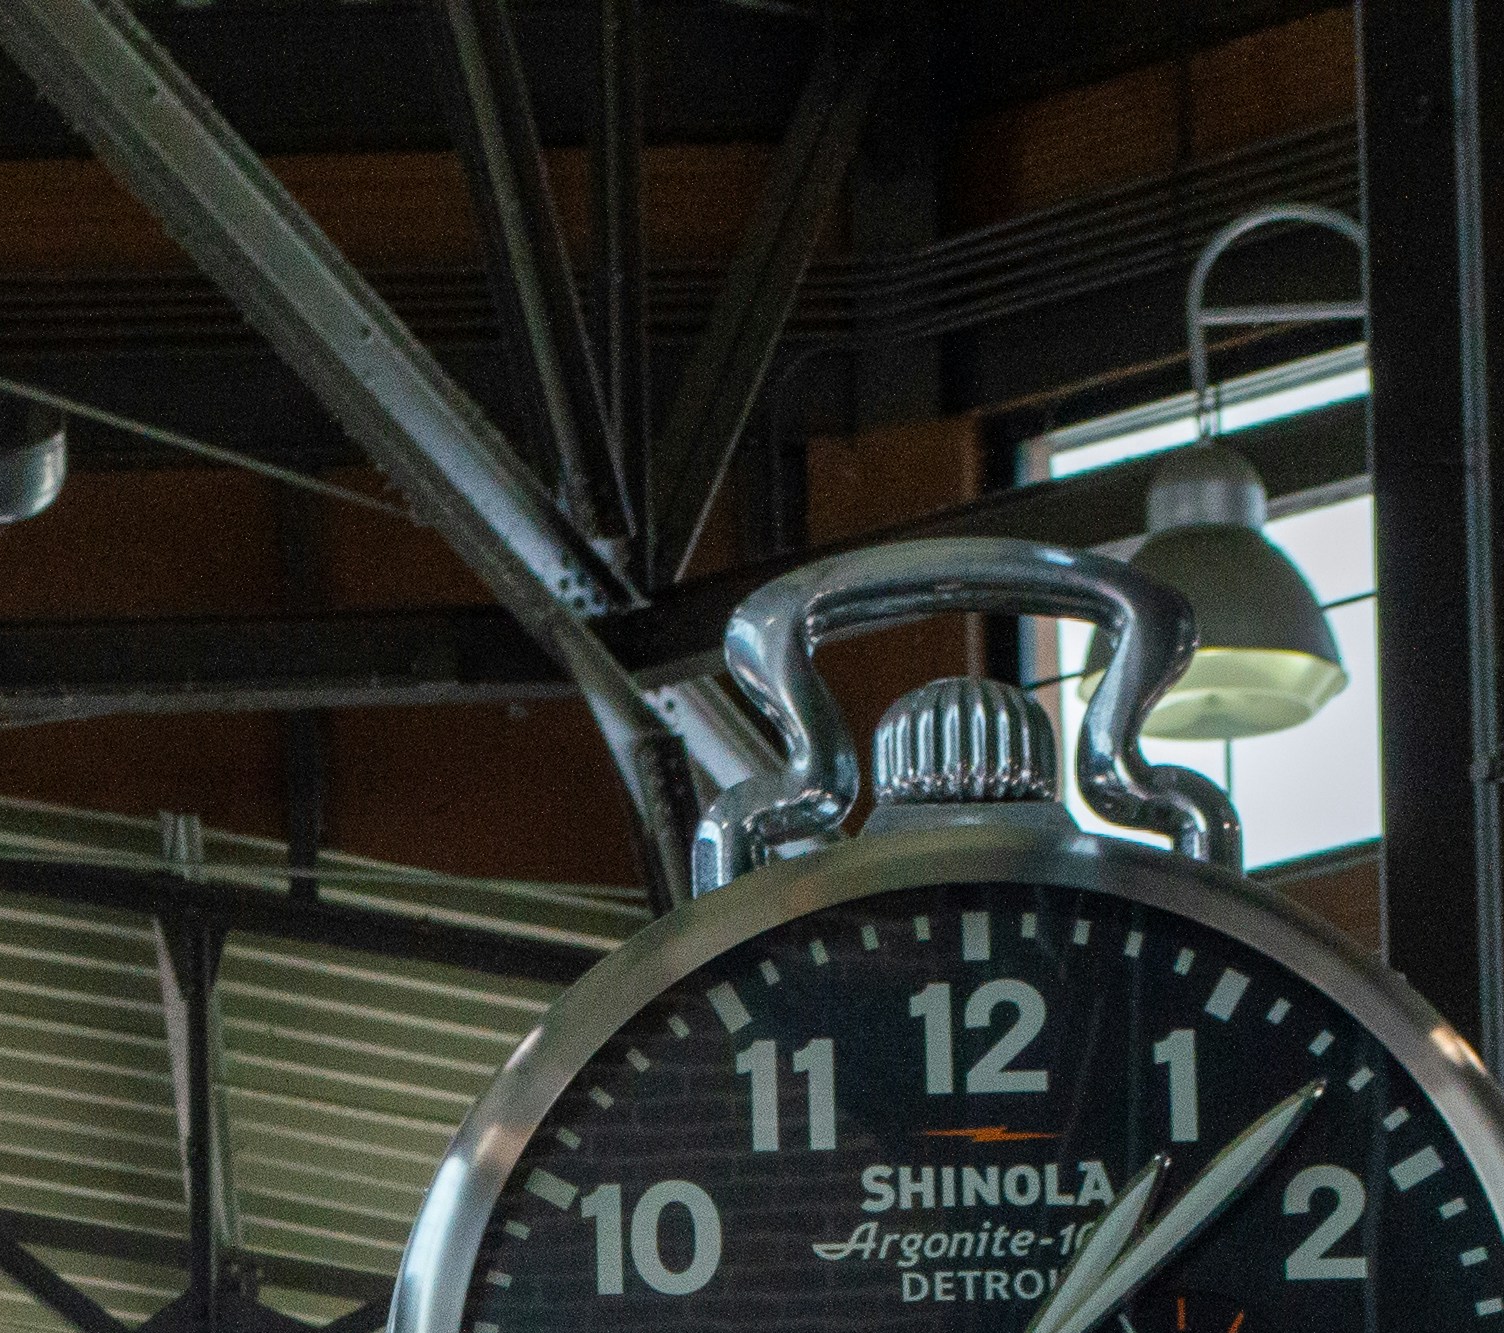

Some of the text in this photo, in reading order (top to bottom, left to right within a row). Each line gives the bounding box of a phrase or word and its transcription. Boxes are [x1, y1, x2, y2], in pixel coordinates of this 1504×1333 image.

[909, 978, 1049, 1095] 12
[1154, 1028, 1198, 1142] 1
[735, 1037, 838, 1153] 11
[580, 1179, 723, 1297] 10
[860, 1160, 1115, 1213] SHINOLA
[1283, 1164, 1369, 1281] 2
[902, 1268, 1056, 1301] DETROI
